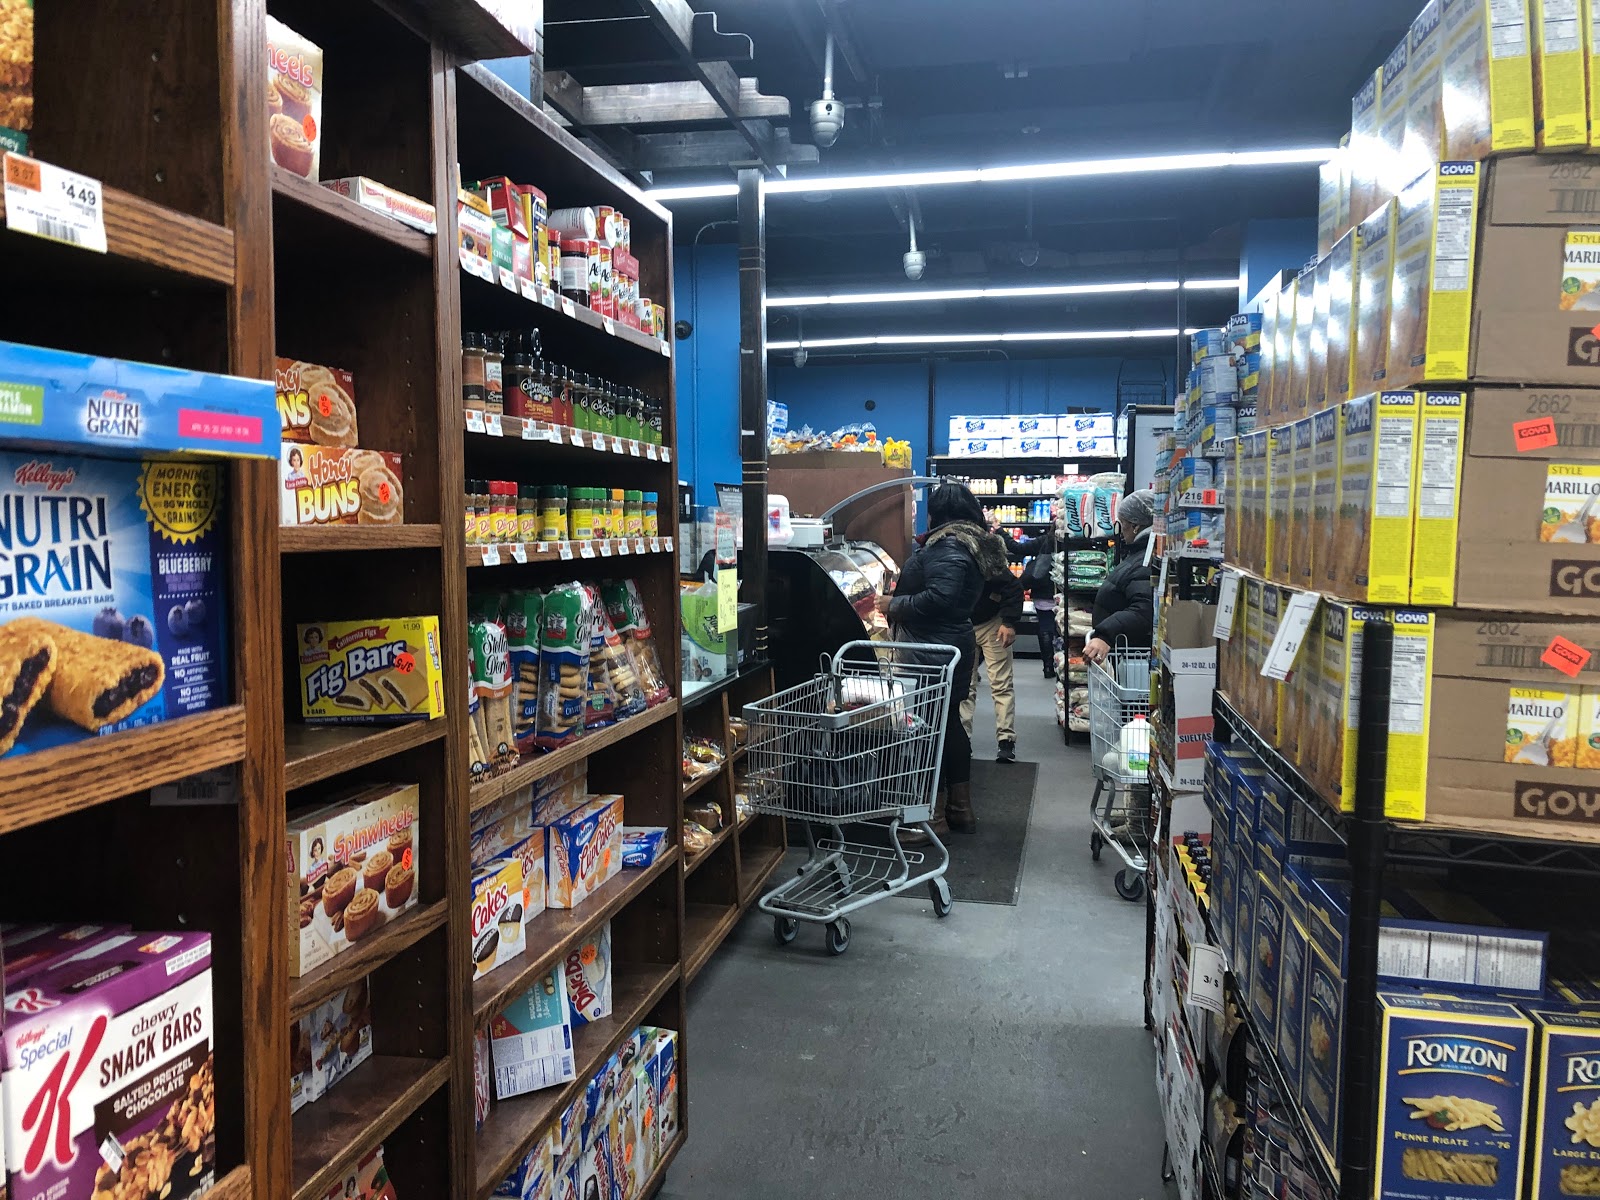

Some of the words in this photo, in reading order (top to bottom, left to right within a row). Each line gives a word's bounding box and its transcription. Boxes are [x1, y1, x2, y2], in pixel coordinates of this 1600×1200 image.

[1441, 164, 1474, 175] GOYA
[1381, 395, 1414, 404] GOYA
[1427, 396, 1460, 405] GOYA
[1526, 394, 1572, 414] 2662
[87, 399, 139, 420] NUTRI
[87, 417, 139, 436] GRAIN
[1520, 426, 1551, 437] GOYA
[15, 460, 75, 490] Kellogg's
[308, 451, 352, 489] Honey
[1552, 466, 1583, 476] STYLE
[153, 481, 210, 498] ENERGY
[298, 480, 361, 524] BUNS
[1066, 497, 1083, 533] Canilla
[1096, 495, 1113, 531] Canilla
[159, 557, 212, 575] BLUEBERRY
[12, 600, 42, 611] BAKED
[44, 597, 92, 608] BREAKFAST
[94, 594, 115, 604] BARS
[1353, 610, 1385, 620] GOYA
[1395, 613, 1428, 623] GOYA
[336, 632, 365, 649] California
[364, 627, 378, 640] Figs
[483, 633, 508, 655] Stella
[171, 655, 190, 666] REAL
[191, 652, 210, 662] FRUIT
[174, 669, 186, 679] NO
[306, 662, 344, 704] Fig
[348, 641, 406, 679] Bars
[180, 687, 191, 697] NO
[1515, 689, 1545, 698] STYLE
[1179, 732, 1212, 743] SUELTAS
[333, 803, 414, 865] Spinwheels
[475, 876, 497, 895] Golden
[471, 884, 508, 939] Cakes
[131, 1002, 179, 1037] chewy
[19, 1026, 73, 1071] Special
[99, 1032, 157, 1088] SNACK
[162, 1006, 202, 1052] BARS
[1407, 1039, 1508, 1073] RONZONI
[22, 1014, 108, 1175] K
[113, 1079, 151, 1114] SALTED
[150, 1056, 194, 1089] PRETZEL
[125, 1077, 184, 1120] CHOCOLATE
[1394, 1131, 1429, 1144] PENNE
[1432, 1135, 1469, 1147] RIGATE
[1497, 1141, 1511, 1149] 76
[1552, 1148, 1587, 1159] LARGE
